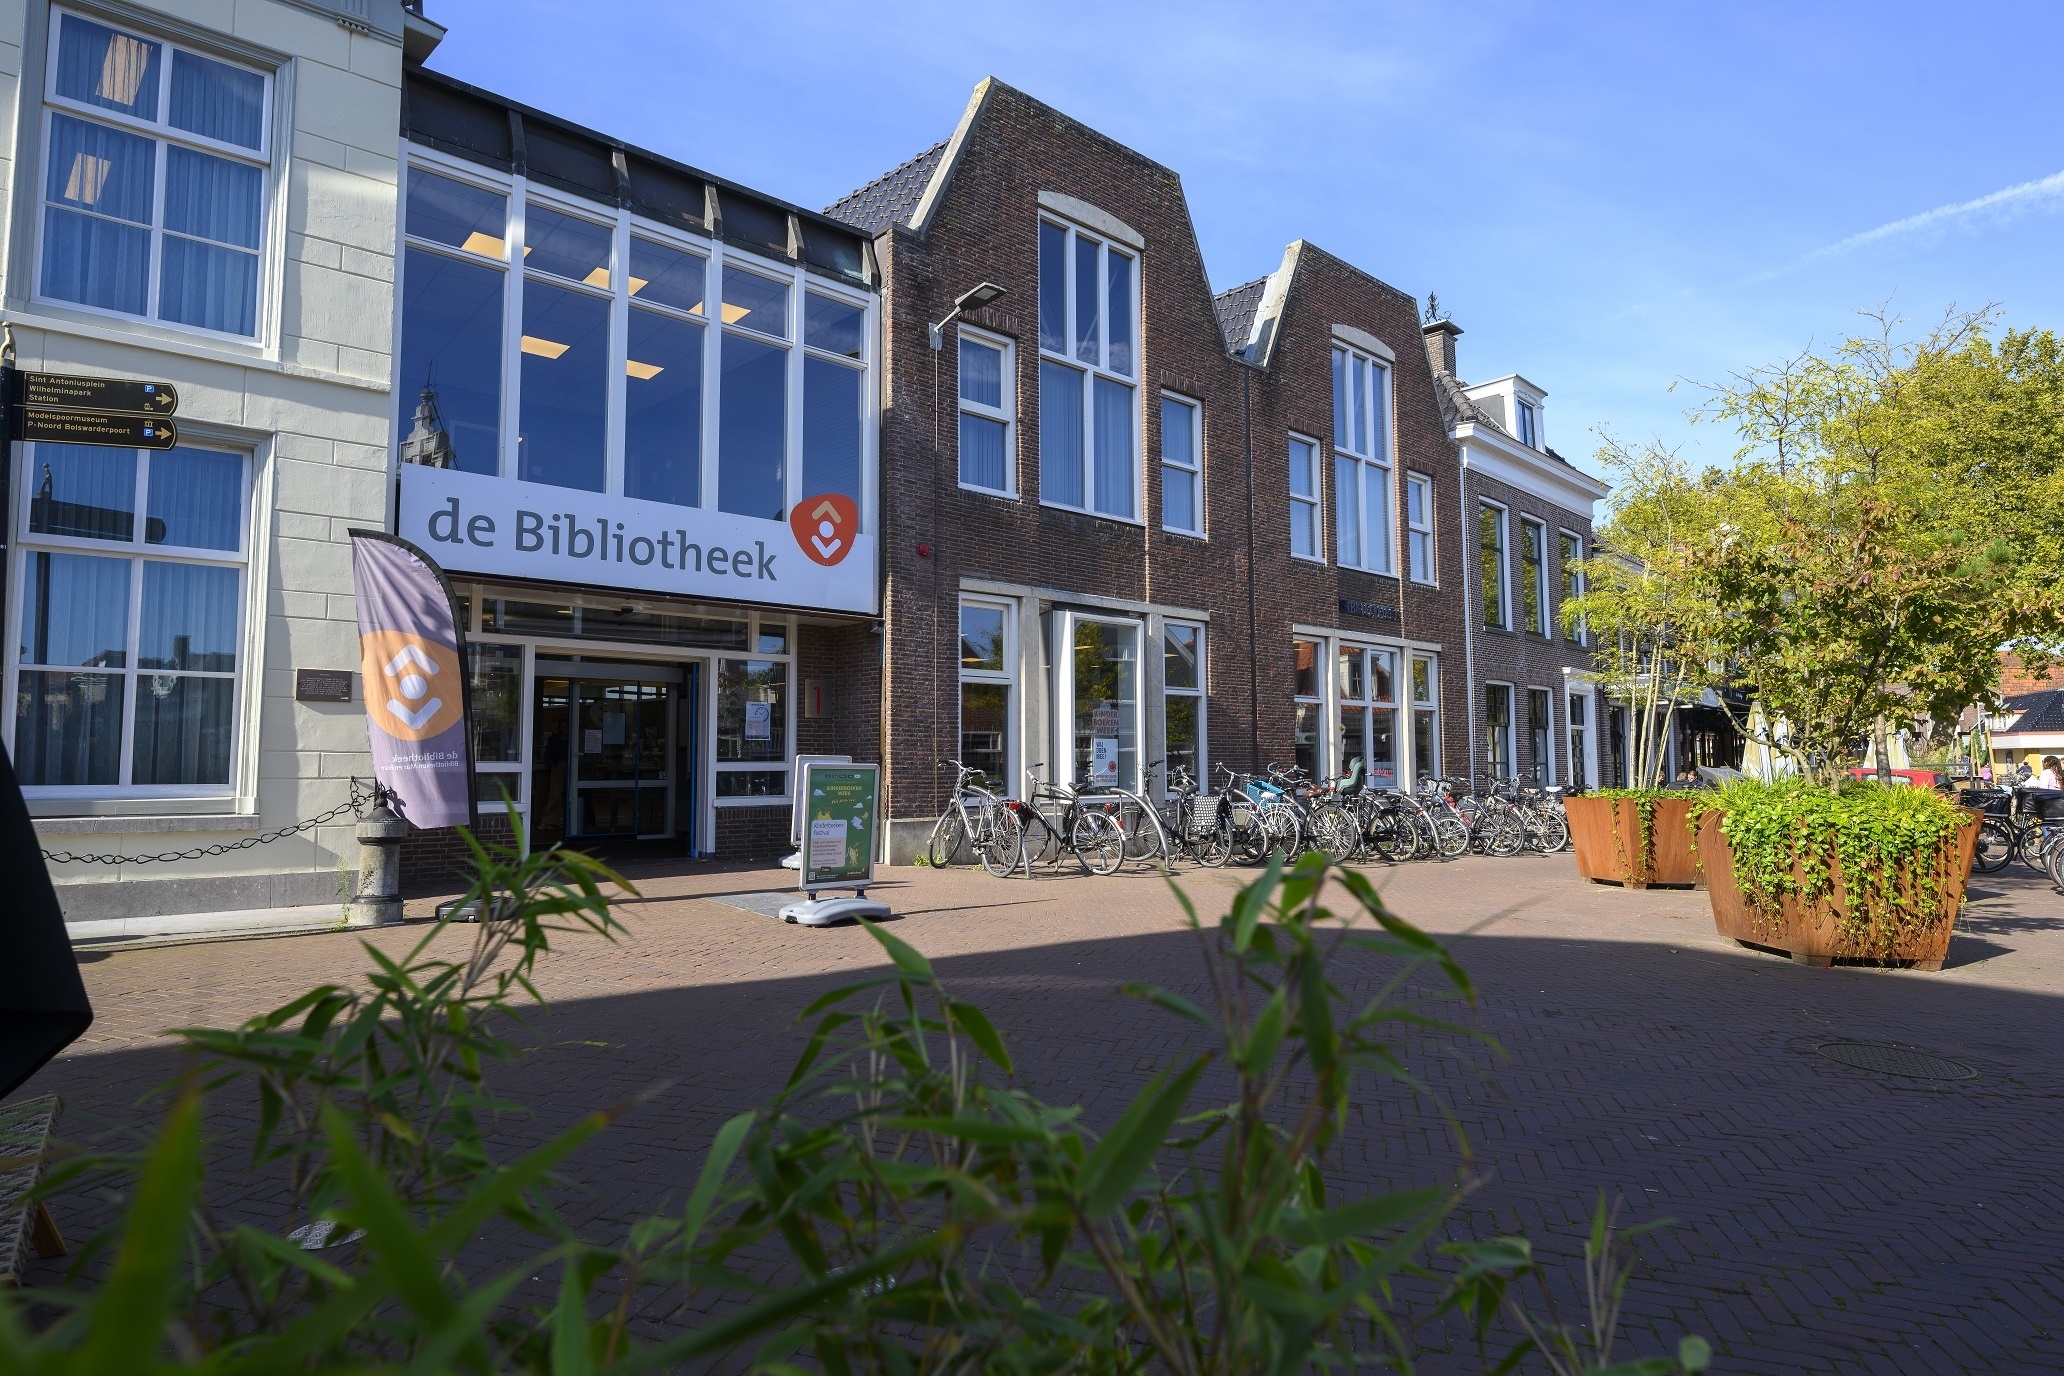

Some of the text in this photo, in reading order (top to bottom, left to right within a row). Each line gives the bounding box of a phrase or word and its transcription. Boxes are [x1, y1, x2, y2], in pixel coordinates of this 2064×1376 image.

[29, 375, 105, 388] Sint Antoniusplein
[29, 385, 92, 396] Wilhelminapark
[29, 394, 59, 402] Station
[28, 411, 108, 423] Modelspoormuseum
[27, 421, 131, 435] P-Noord Bolswarderpoort
[427, 496, 777, 581] de Bibliotheek
[813, 686, 821, 715] 1
[1093, 719, 1119, 727] BOEKEN
